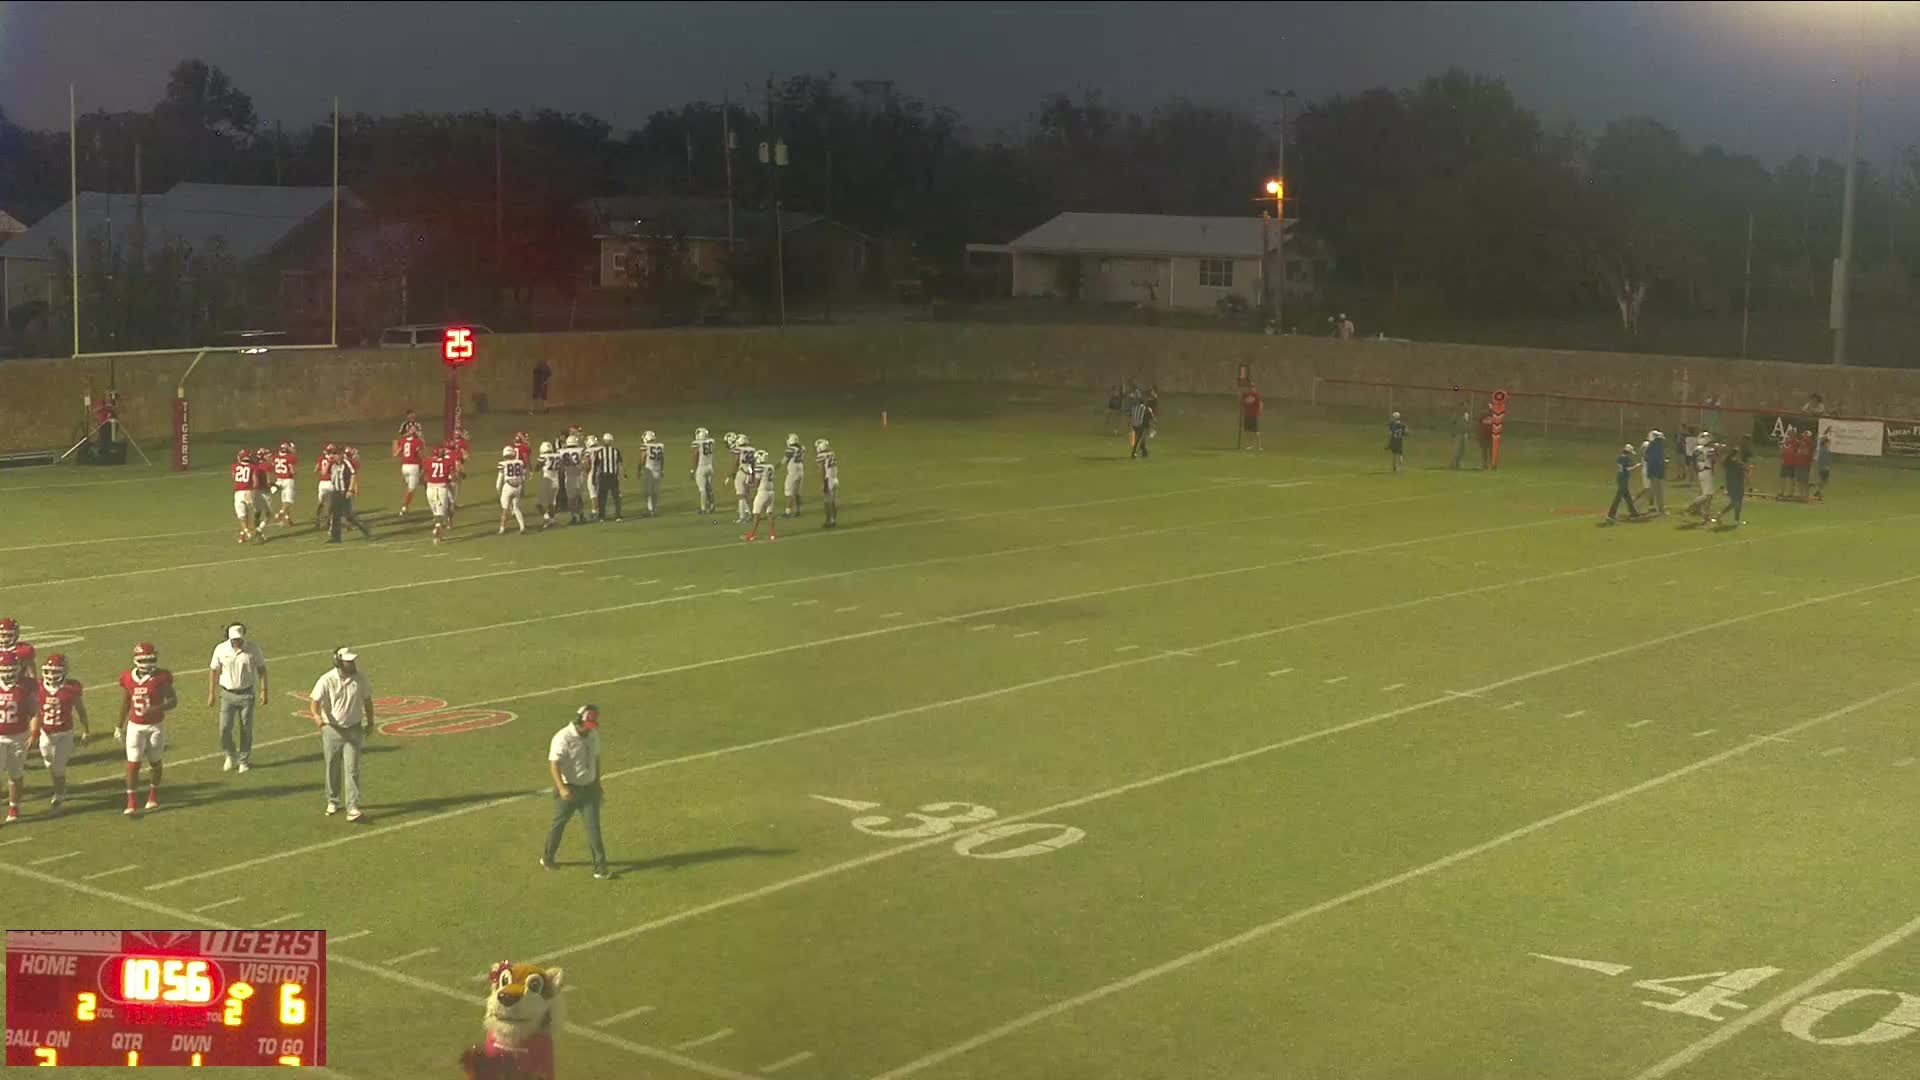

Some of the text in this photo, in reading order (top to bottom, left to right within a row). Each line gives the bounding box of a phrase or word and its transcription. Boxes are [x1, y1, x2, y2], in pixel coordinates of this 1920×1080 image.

[445, 329, 473, 358] 25
[181, 401, 189, 465] TIGERS
[234, 465, 251, 483] 20
[274, 458, 288, 474] 25
[431, 462, 444, 478] 71
[506, 462, 522, 478] 88
[851, 801, 1086, 859] 30
[1631, 965, 1920, 1046] 40
